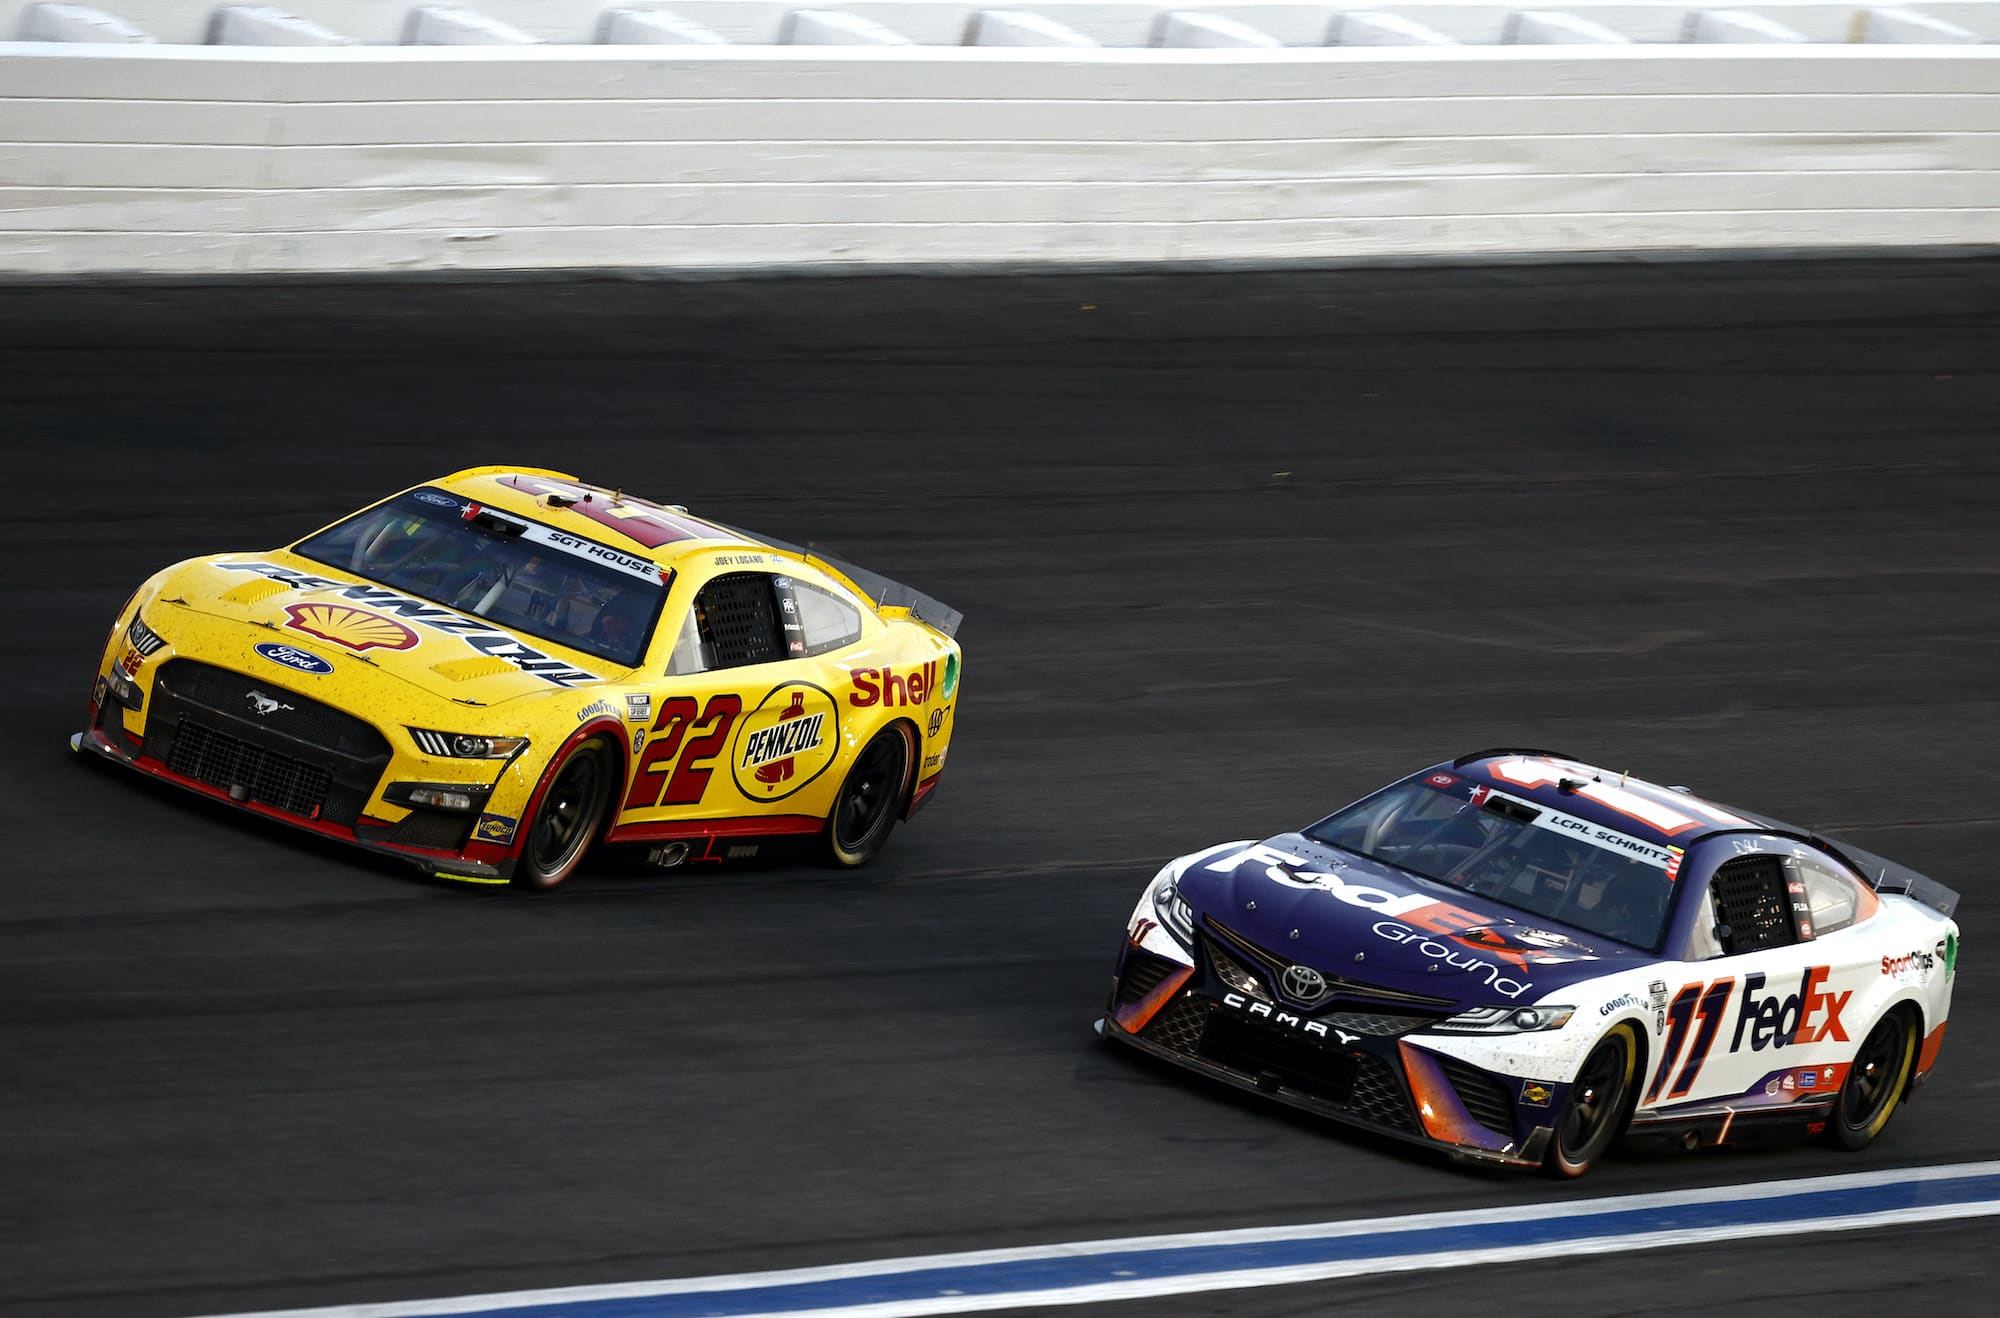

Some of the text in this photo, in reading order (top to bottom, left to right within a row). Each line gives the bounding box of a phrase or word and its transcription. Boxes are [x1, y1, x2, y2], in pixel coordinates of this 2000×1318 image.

[548, 532, 656, 576] SGT HOUSE
[715, 556, 733, 566] JOEY
[122, 648, 145, 677] 22
[267, 646, 320, 669] Ford
[849, 661, 937, 707] Shell
[623, 694, 742, 811] 22
[740, 712, 838, 770] PENNZOIL
[1550, 815, 1673, 864] LCPL SCHMITZ
[1372, 920, 1532, 999] Ground
[1223, 992, 1361, 1045] CAMRY
[1729, 965, 1853, 1053] FedEx
[1642, 976, 1735, 1106] 11
